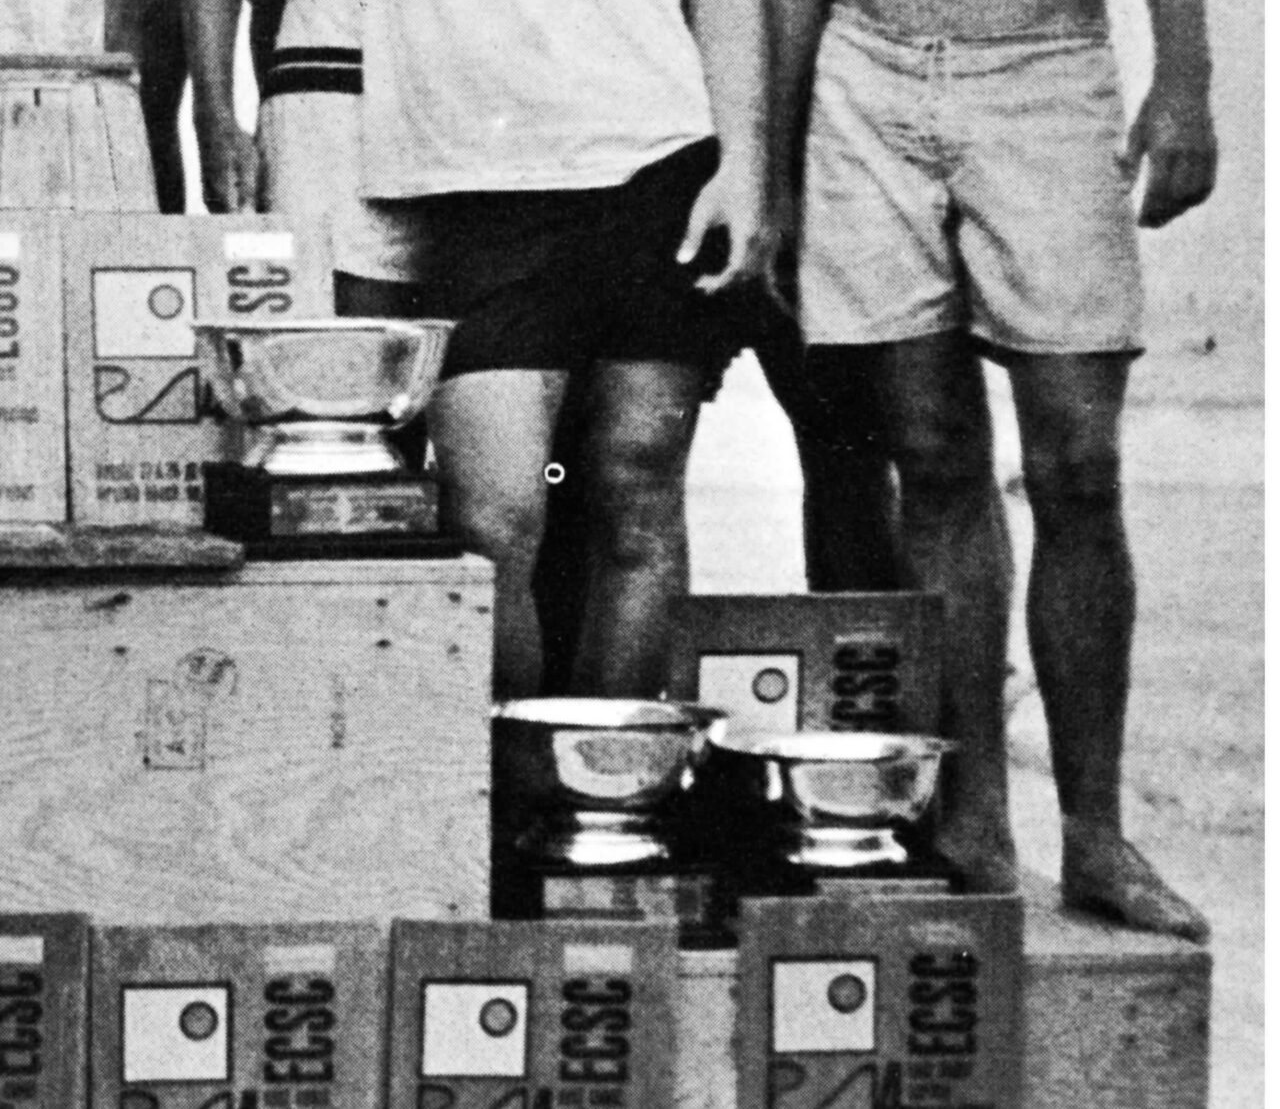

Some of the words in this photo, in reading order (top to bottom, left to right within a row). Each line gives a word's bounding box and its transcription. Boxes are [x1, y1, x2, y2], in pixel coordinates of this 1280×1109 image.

[226, 265, 294, 314] SC
[264, 978, 336, 1083] ECSC
[559, 978, 632, 1083] ECSC
[907, 952, 978, 1056] ECSC
